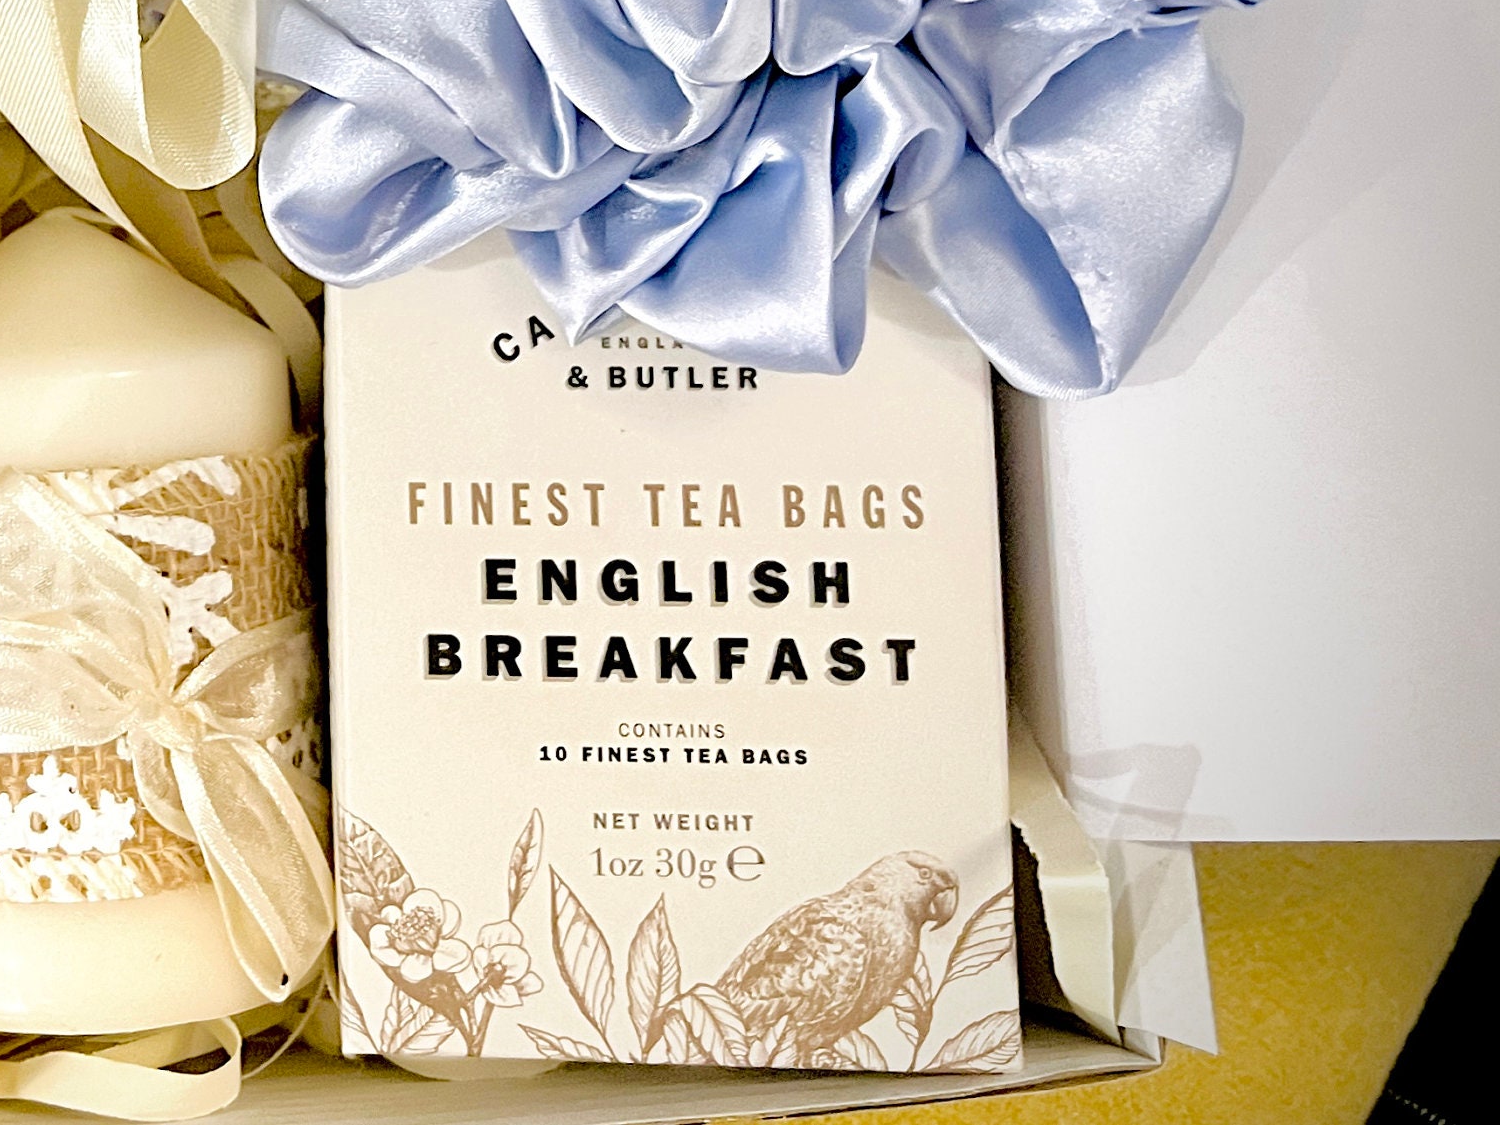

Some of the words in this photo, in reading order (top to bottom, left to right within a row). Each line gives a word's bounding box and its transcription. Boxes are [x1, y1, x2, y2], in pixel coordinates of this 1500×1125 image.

[601, 336, 684, 350] ENGLA
[566, 365, 589, 389] &
[607, 365, 758, 391] BUTLER
[408, 481, 605, 527] FINEST
[642, 482, 743, 529] TEA
[782, 484, 925, 530] BAGS
[483, 557, 851, 607] ENGLISH
[426, 633, 916, 682] BREAKFAST
[618, 722, 726, 740] CONTAINS
[539, 745, 568, 762] 10
[581, 746, 671, 764] FINEST
[683, 747, 729, 765] TEA
[741, 748, 808, 766] BAGS
[593, 812, 640, 831] NET
[652, 813, 754, 832] WEIGHT
[591, 847, 644, 877] 1oz
[655, 847, 718, 890] 30g
